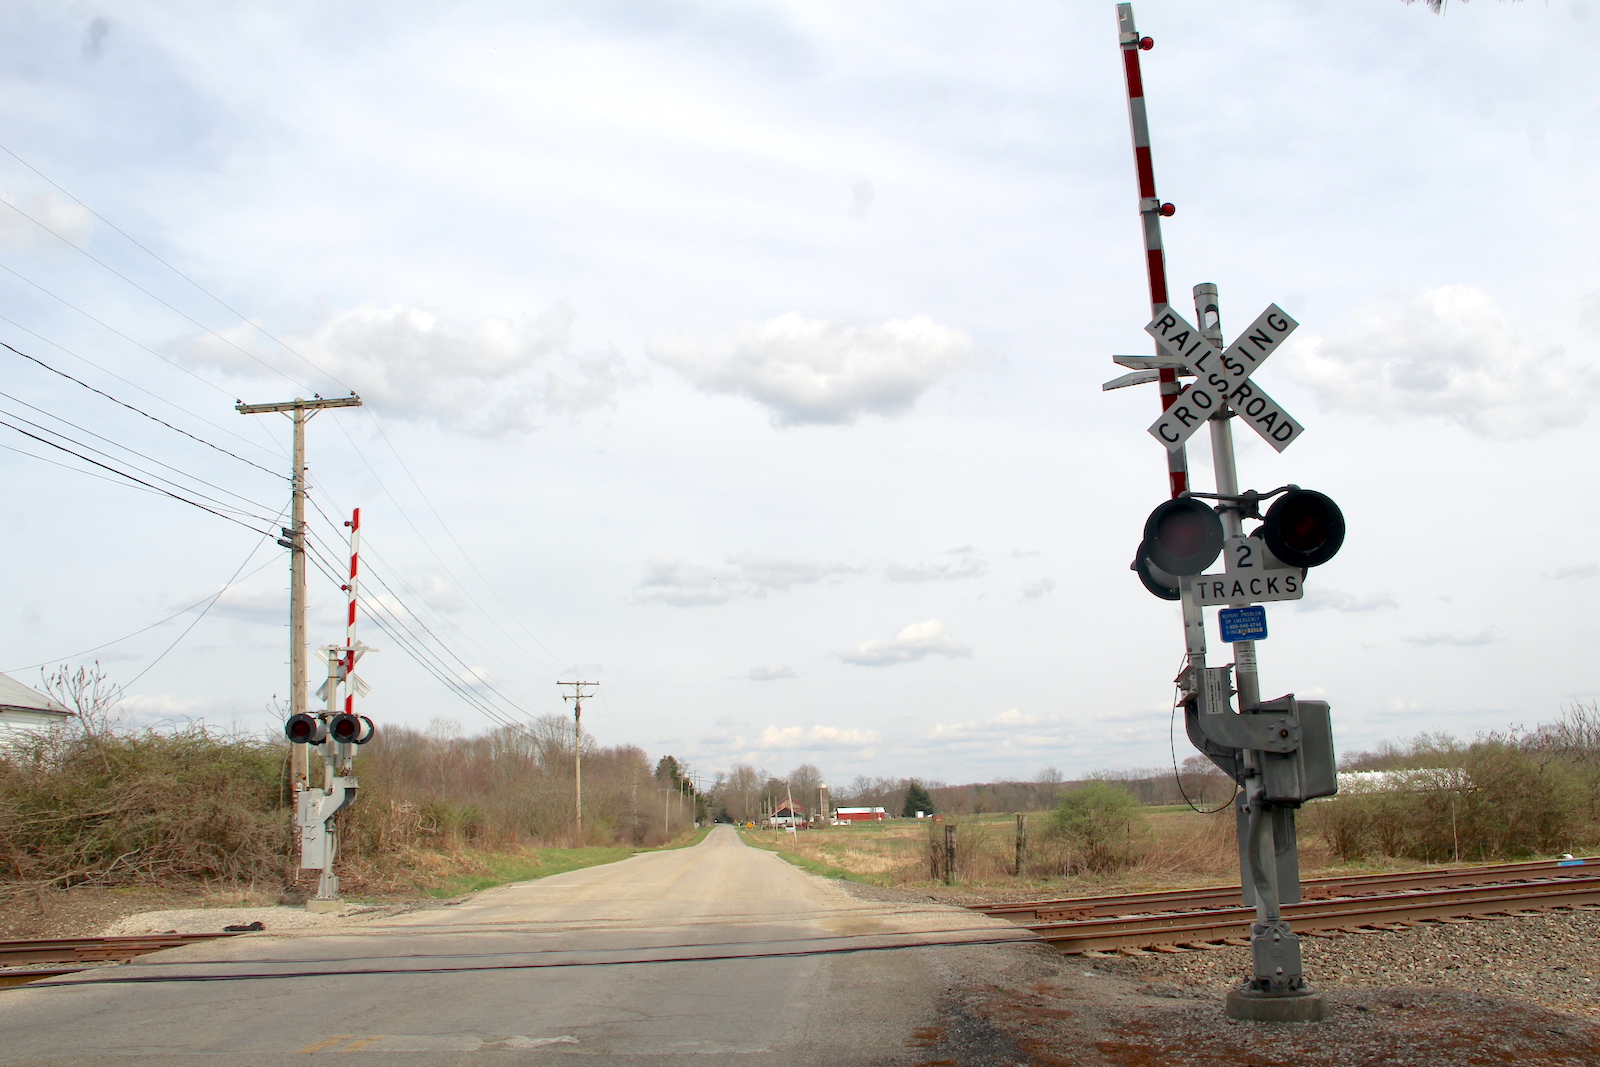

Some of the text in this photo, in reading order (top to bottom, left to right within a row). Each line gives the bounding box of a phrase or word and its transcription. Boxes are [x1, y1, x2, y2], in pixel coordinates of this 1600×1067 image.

[1158, 313, 1288, 443] CROSSING
[1236, 545, 1253, 568] 2
[1197, 576, 1297, 599] TRACKS
